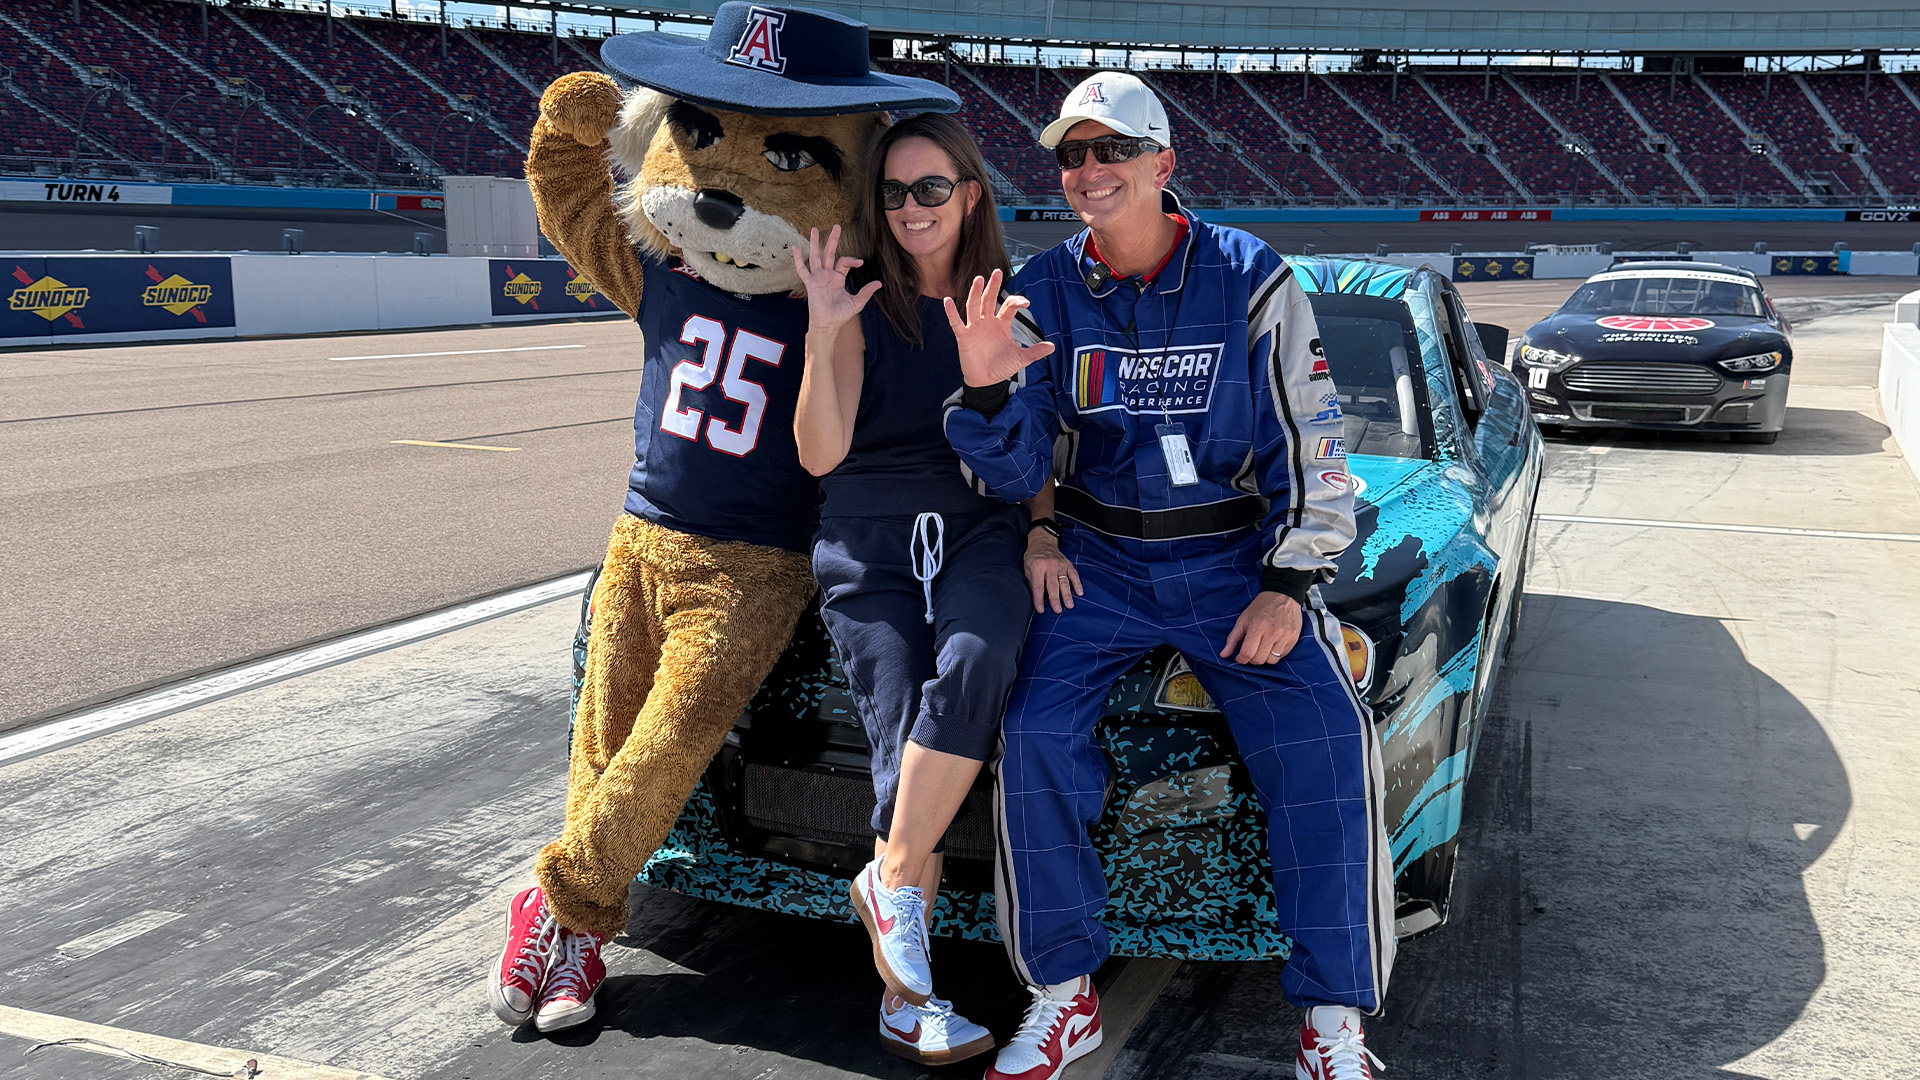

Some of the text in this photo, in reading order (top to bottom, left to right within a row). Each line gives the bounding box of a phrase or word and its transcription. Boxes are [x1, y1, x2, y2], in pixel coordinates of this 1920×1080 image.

[45, 183, 120, 202] TURN 4
[1042, 211, 1081, 221] PIT BOS
[1432, 212, 1537, 220] ABB ABB ABB ABB
[1860, 212, 1911, 222] GOVX
[145, 287, 208, 304] SUNOCO
[505, 282, 539, 295] SUNOCO
[11, 289, 86, 308] SUNOCO
[1118, 352, 1213, 380] NASCAR
[660, 313, 787, 459] 25
[1119, 380, 1207, 394] RACING
[1528, 367, 1549, 390] 10
